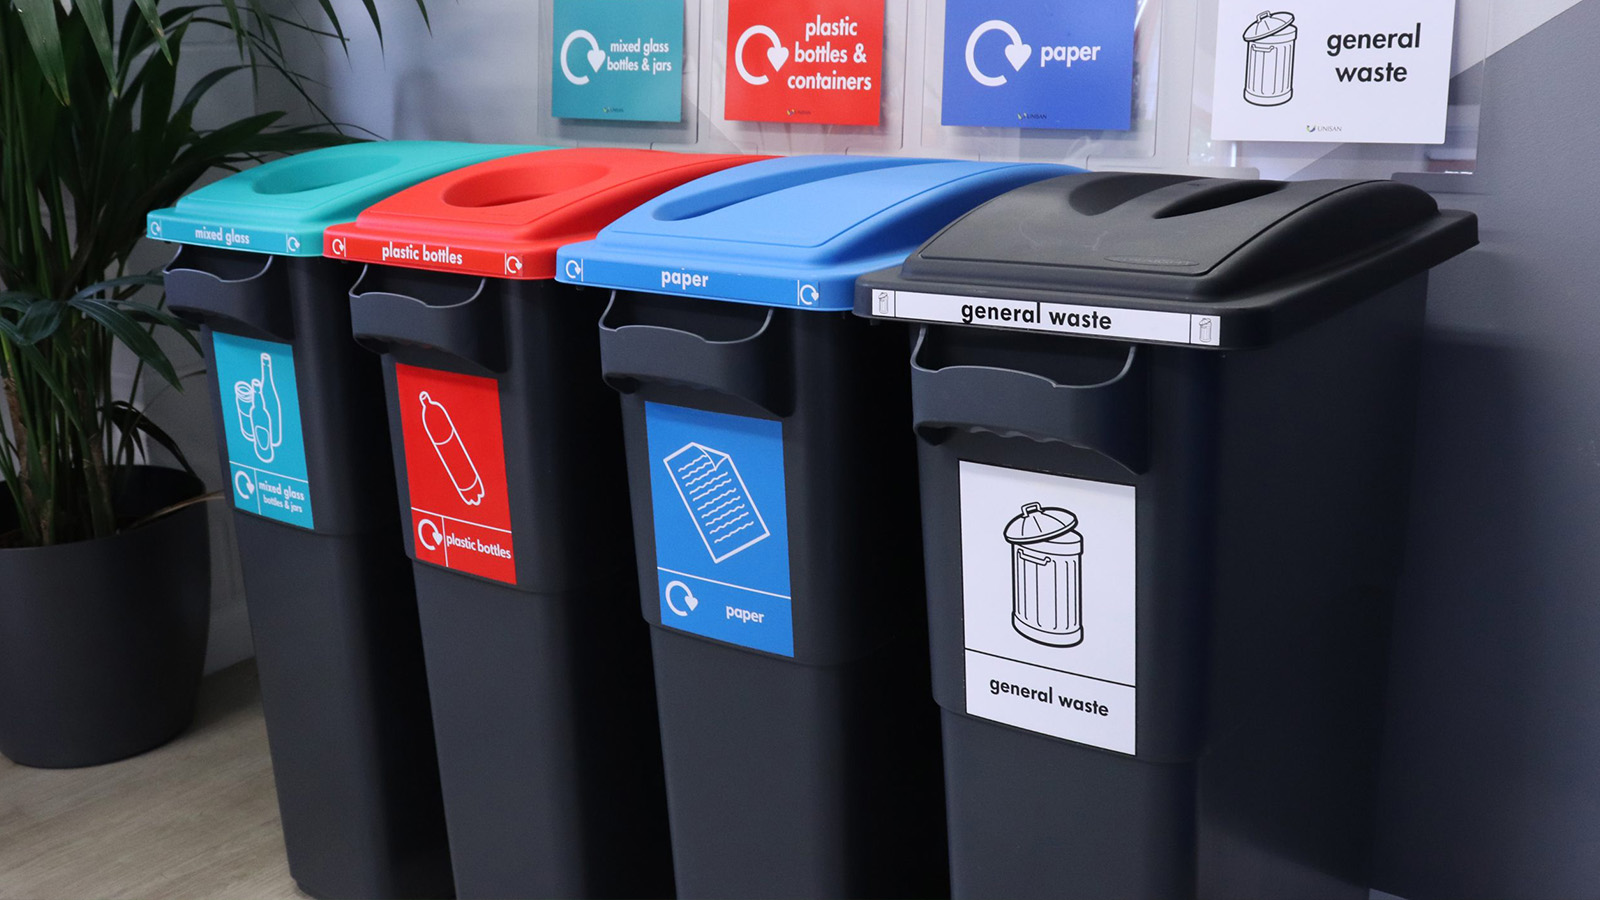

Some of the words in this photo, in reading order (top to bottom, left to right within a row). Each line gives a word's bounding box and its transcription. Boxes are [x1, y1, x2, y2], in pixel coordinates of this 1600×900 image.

[805, 14, 858, 42] plastic
[610, 38, 641, 53] mixed
[643, 38, 670, 56] glass
[1326, 22, 1421, 57] general
[794, 41, 848, 64] bottles
[853, 43, 868, 64] &
[1040, 45, 1101, 68] paper
[607, 56, 639, 71] bottles
[641, 57, 650, 71] &
[652, 57, 672, 75] jars
[1335, 62, 1408, 83] waste
[787, 70, 872, 92] containers
[195, 226, 223, 242] mixed
[225, 228, 250, 245] glass
[382, 242, 420, 262] plastic
[423, 244, 464, 265] bottles
[661, 270, 709, 290] paper
[961, 302, 1041, 324] general
[1048, 311, 1112, 330] waste
[258, 480, 282, 495] mixed
[283, 485, 305, 501] glass
[263, 494, 283, 508] bottles
[290, 501, 303, 513] jars
[446, 532, 476, 551] plastic
[477, 539, 512, 559] bottles
[726, 605, 765, 624] paper
[989, 678, 1053, 705] general
[1058, 695, 1109, 717] waste
